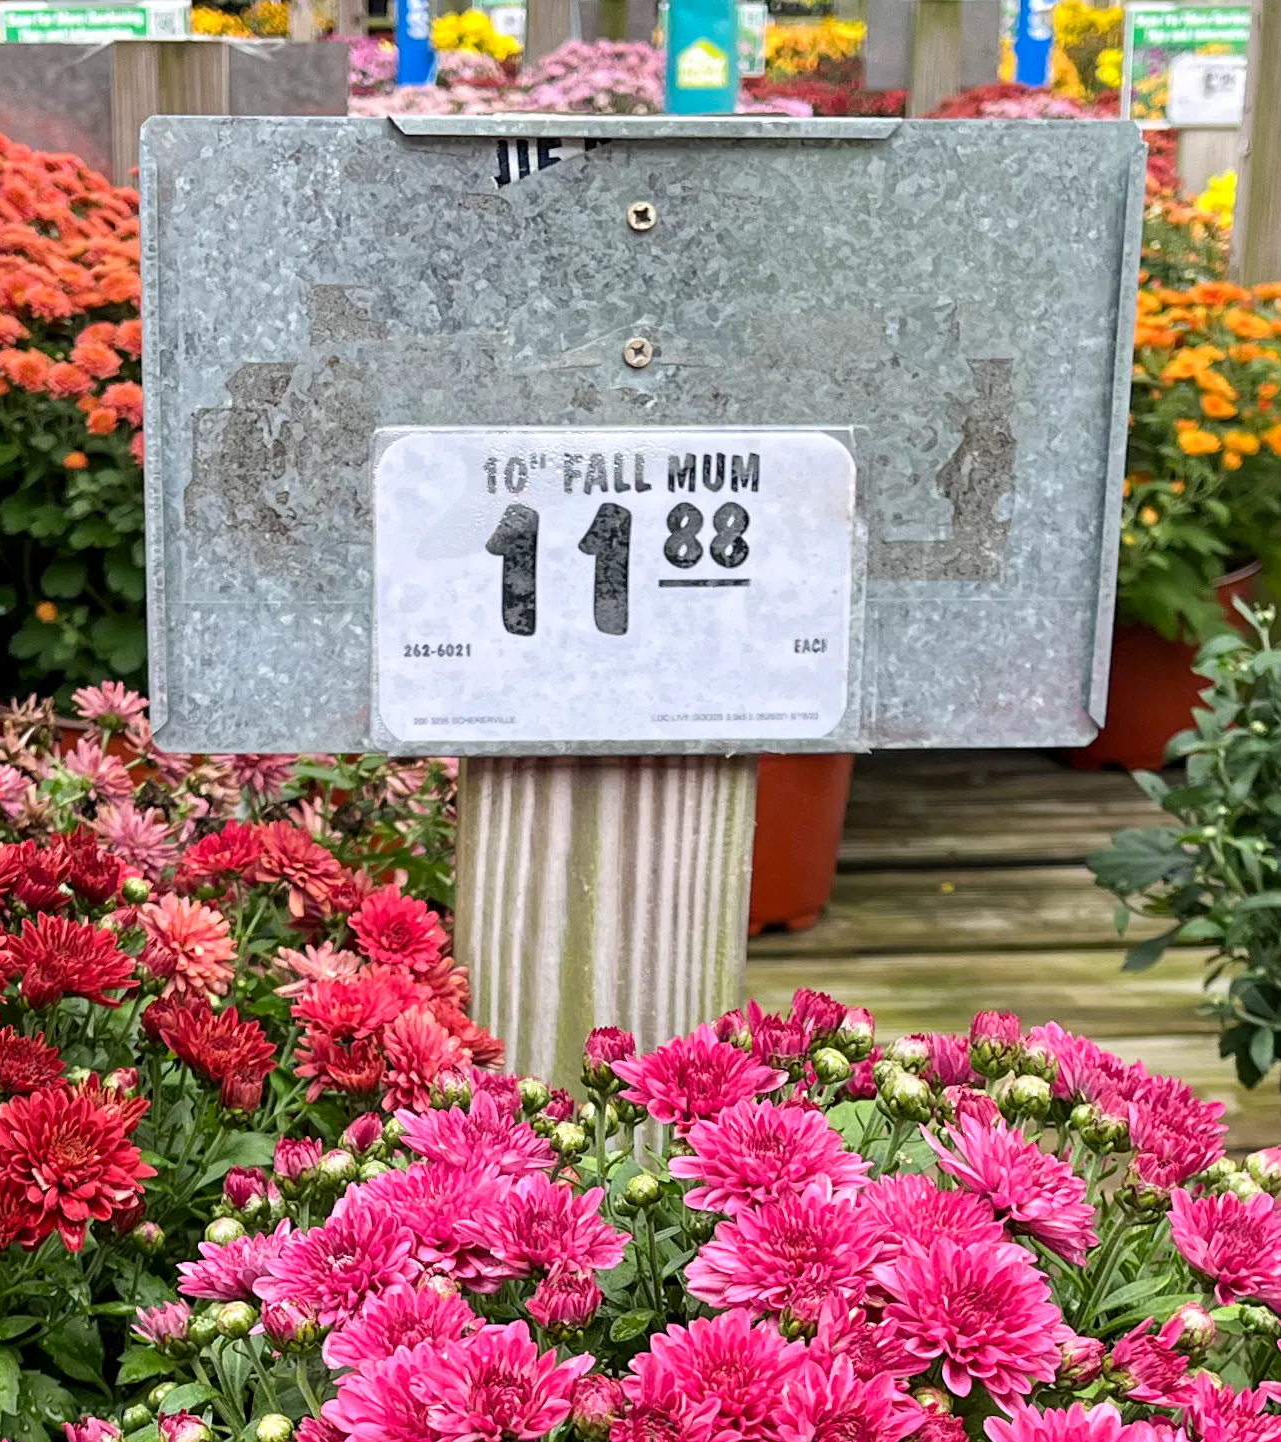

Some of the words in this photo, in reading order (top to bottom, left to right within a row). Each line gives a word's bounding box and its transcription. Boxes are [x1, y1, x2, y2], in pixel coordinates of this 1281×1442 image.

[484, 453, 546, 494] 10"
[564, 453, 652, 494] FALL
[668, 452, 760, 493] MUM
[663, 501, 751, 569] 88
[403, 643, 471, 657] 262-6021
